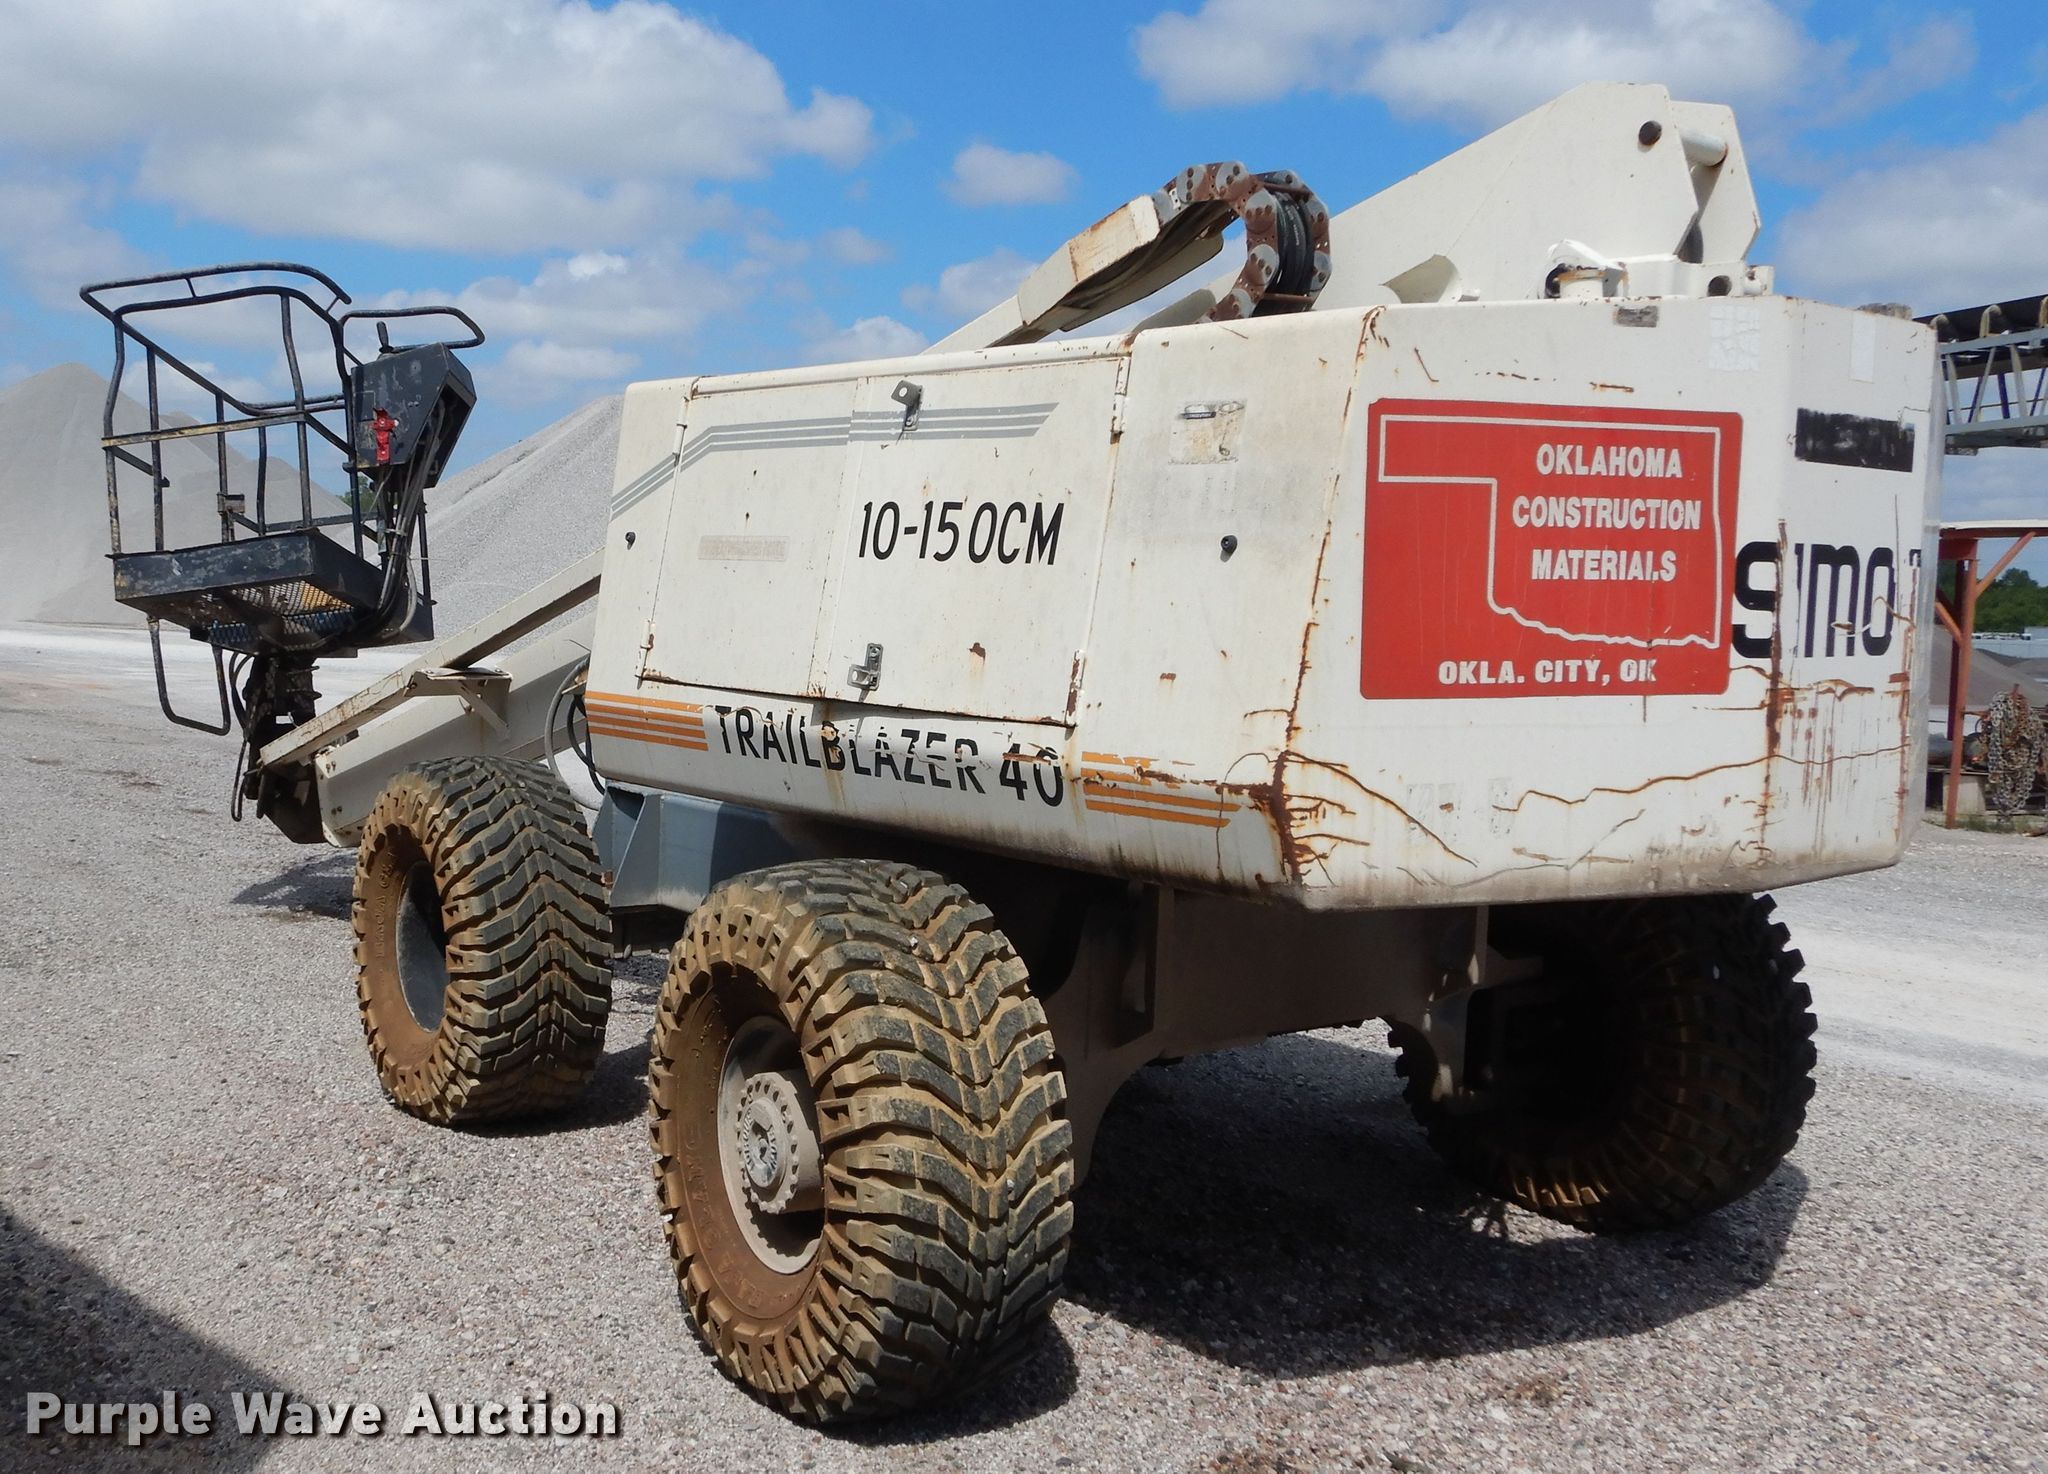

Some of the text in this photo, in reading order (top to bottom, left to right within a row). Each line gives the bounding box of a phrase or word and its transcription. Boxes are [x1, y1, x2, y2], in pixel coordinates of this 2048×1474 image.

[1536, 443, 1683, 478] OKLAHOMA
[1512, 495, 1702, 530] CONSTRUCTION
[858, 501, 1065, 566] 10-150CM
[1531, 549, 1677, 582] MATERIALS
[1438, 658, 1658, 687] OKLA. CITY, OK
[714, 704, 1065, 807] TRAILBLAZER 40
